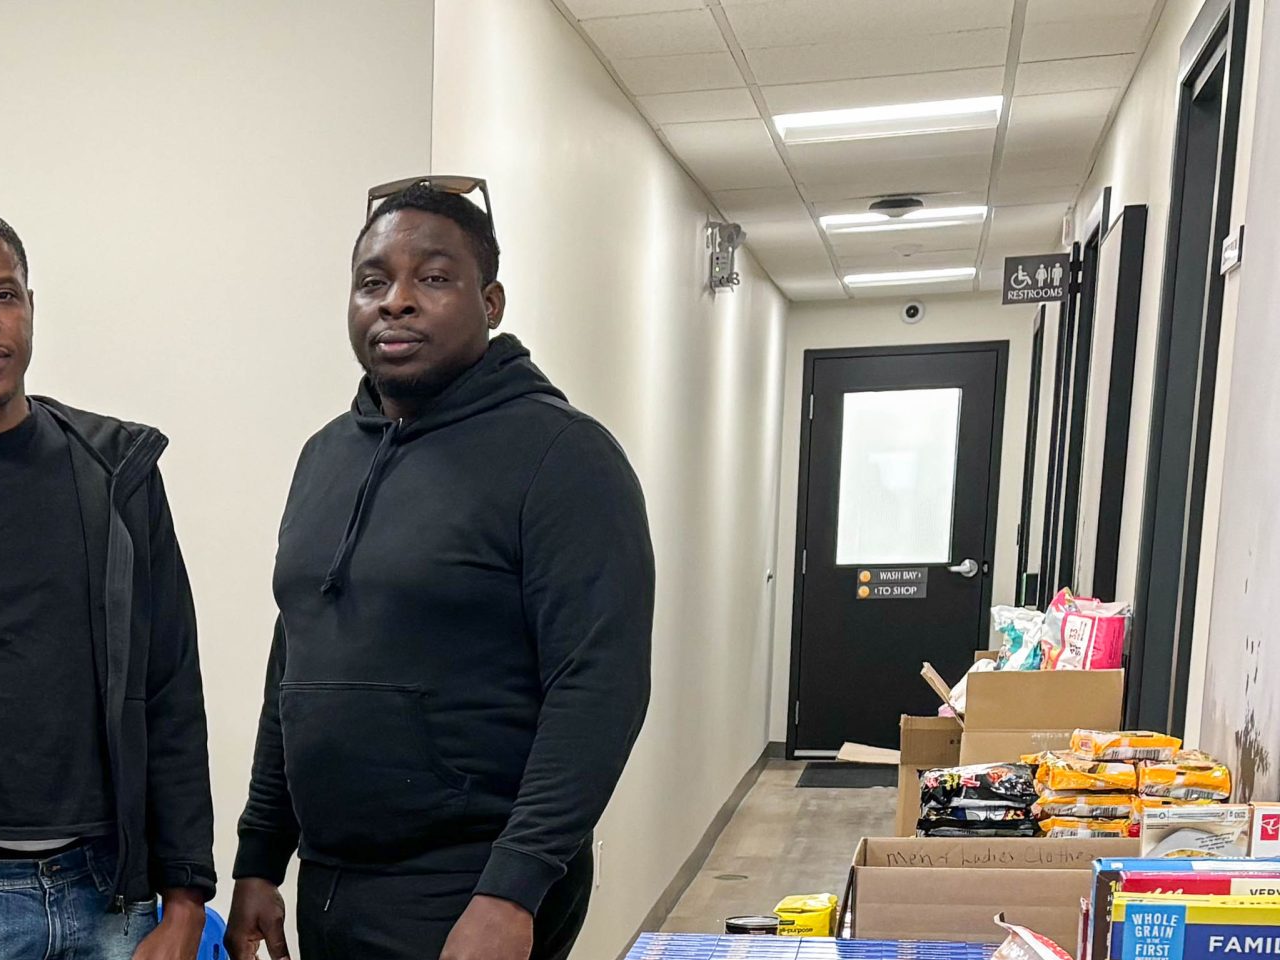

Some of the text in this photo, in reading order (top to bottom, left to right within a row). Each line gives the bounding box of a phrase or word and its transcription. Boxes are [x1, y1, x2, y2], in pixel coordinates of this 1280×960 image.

[1007, 287, 1063, 300] RESTROOMS
[879, 571, 918, 581] WASH BAY
[879, 586, 918, 596] TO SHOP
[1131, 912, 1180, 927] WHOLE
[1135, 925, 1174, 939] GRAIN
[1135, 944, 1170, 957] FIRST
